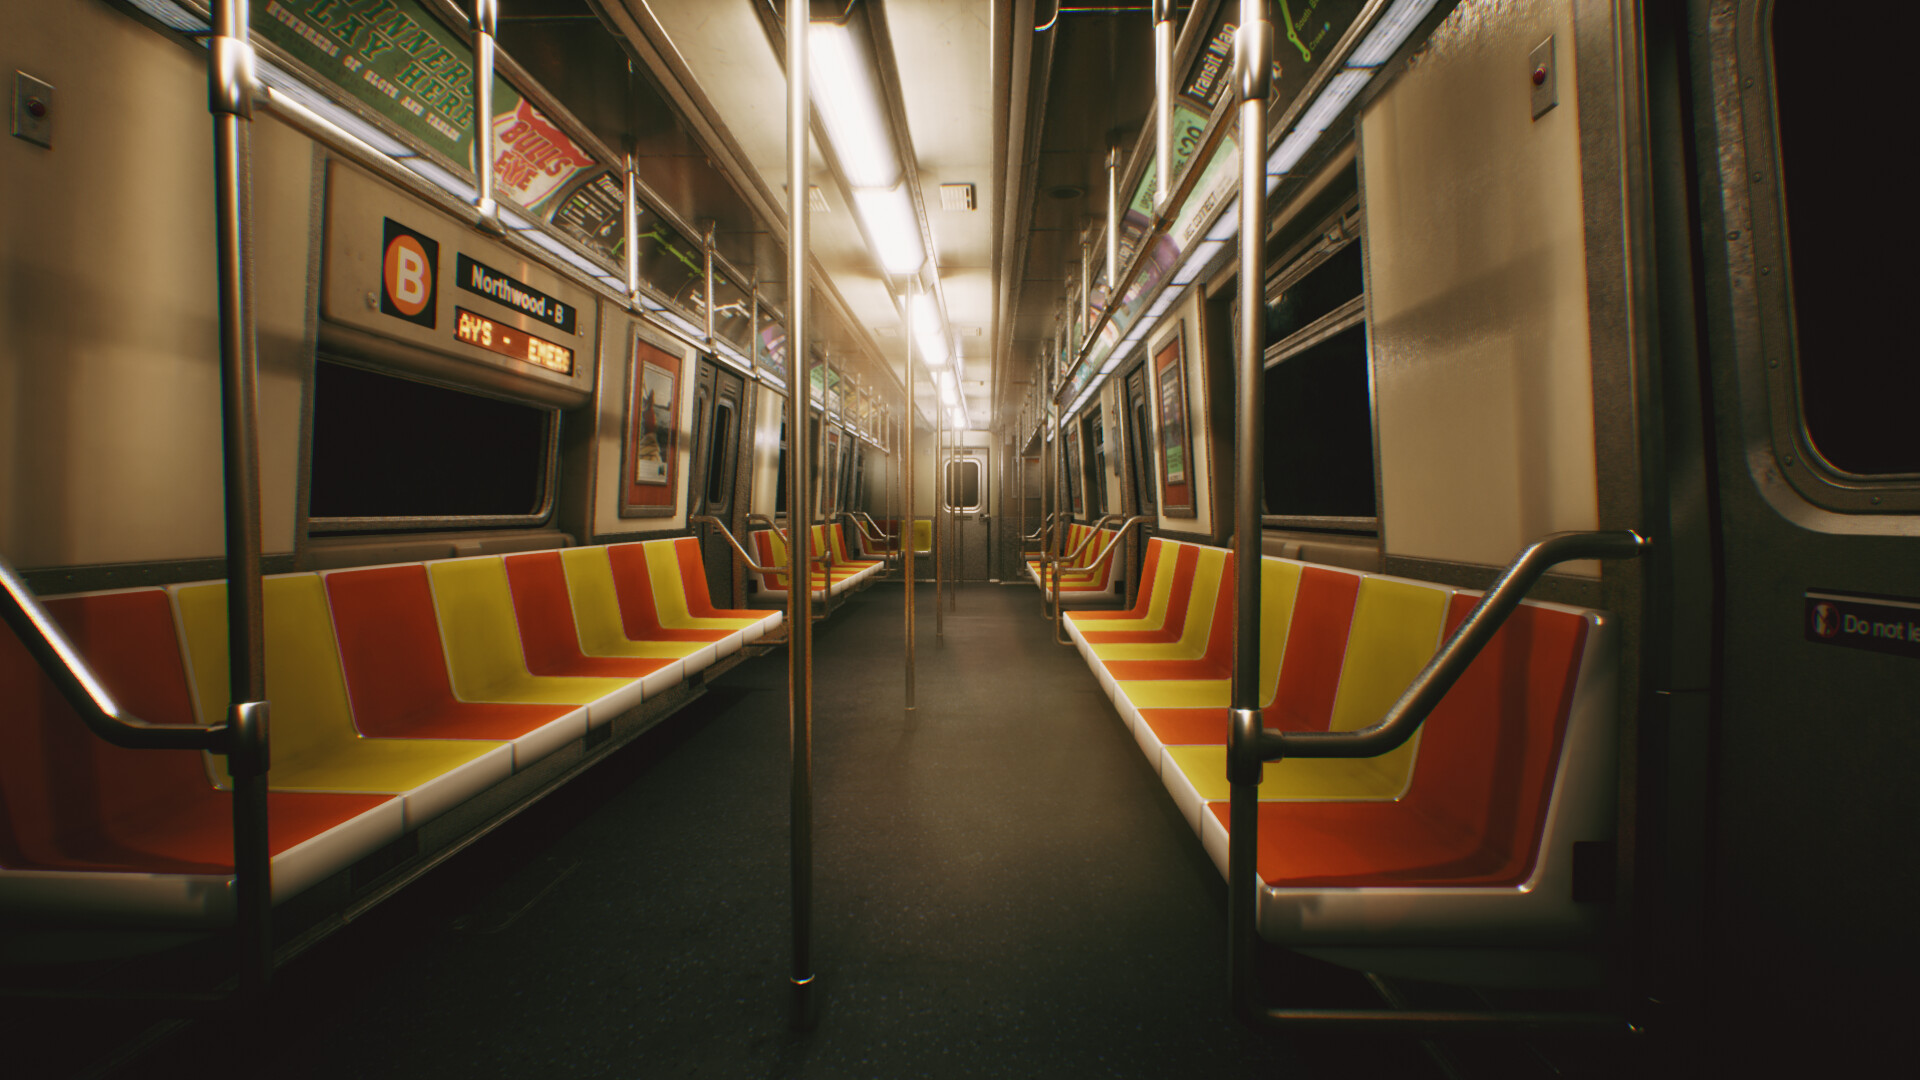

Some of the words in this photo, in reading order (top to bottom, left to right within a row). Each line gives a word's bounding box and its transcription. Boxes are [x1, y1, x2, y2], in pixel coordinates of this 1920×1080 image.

[287, 0, 395, 62] LAY
[395, 60, 472, 130] HERE
[343, 0, 471, 98] INNERS
[1187, 53, 1223, 98] Transit
[343, 54, 364, 73] OF
[363, 69, 400, 100] SLOTS
[400, 96, 425, 117] AND
[494, 149, 538, 191] EYE
[500, 120, 574, 177] BULLS
[396, 245, 425, 304] B
[472, 264, 546, 317] Northwood
[554, 303, 564, 324] B
[459, 313, 493, 346] AYS
[1842, 613, 1870, 635] Do
[1872, 620, 1905, 640] not
